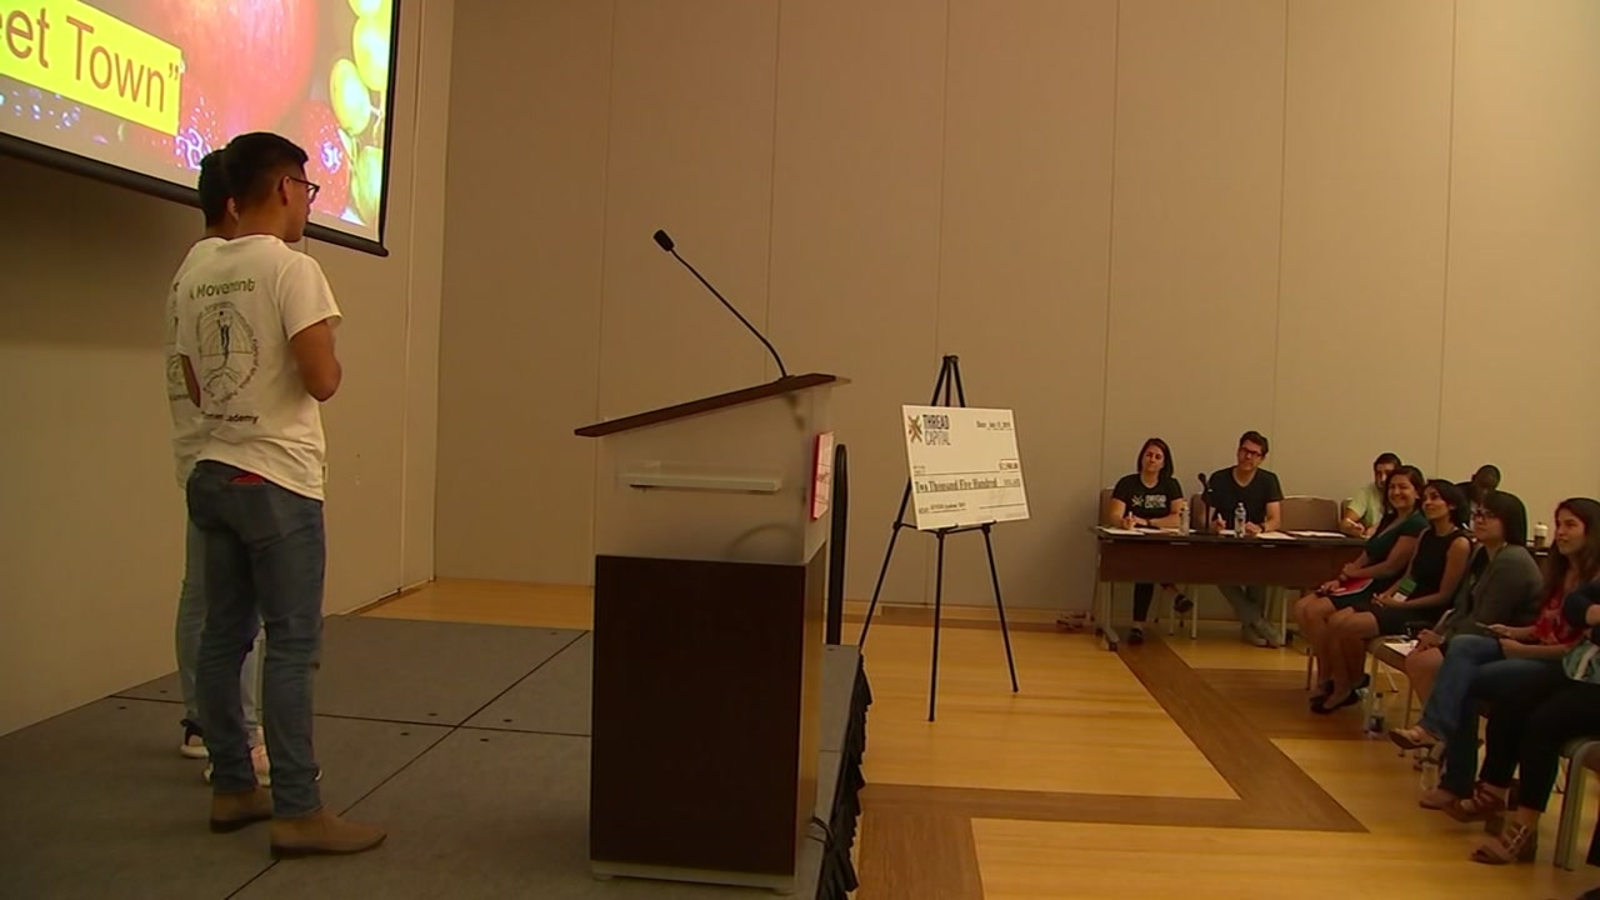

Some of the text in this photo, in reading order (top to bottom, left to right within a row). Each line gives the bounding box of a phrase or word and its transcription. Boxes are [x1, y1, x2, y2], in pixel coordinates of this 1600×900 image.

[0, 8, 50, 69] et
[922, 414, 950, 430] THREAD
[924, 430, 951, 446] CAPITAL
